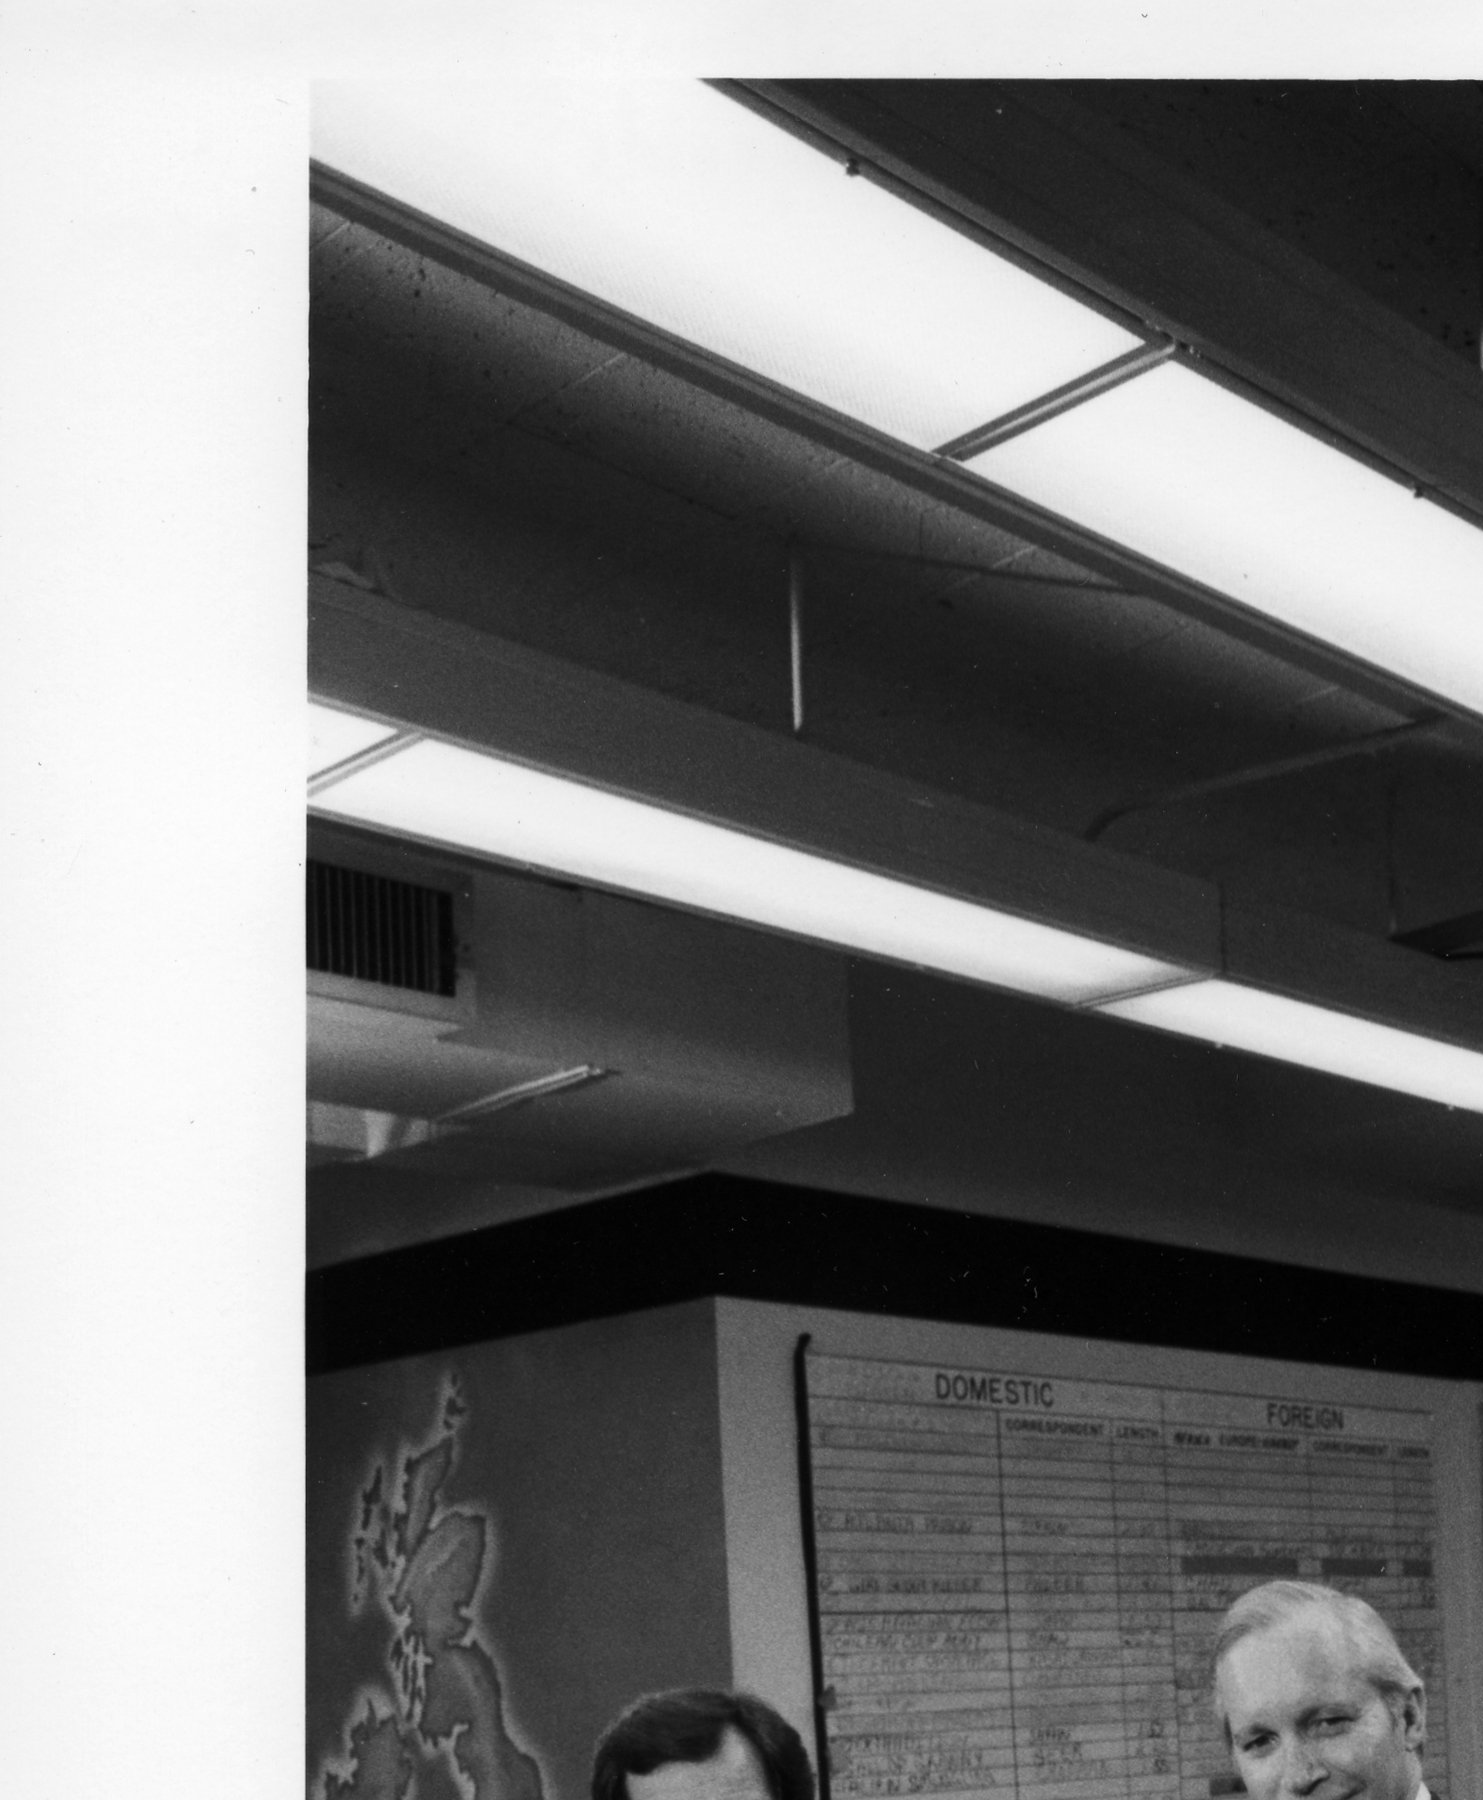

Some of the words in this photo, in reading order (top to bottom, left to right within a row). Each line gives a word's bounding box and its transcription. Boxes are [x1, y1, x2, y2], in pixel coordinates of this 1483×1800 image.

[934, 1372, 1054, 1408] DOMESTIC
[1005, 1417, 1104, 1437] CORRESPONDENT
[1266, 1402, 1345, 1430] FOREIGN
[1115, 1426, 1160, 1442] LENGTH
